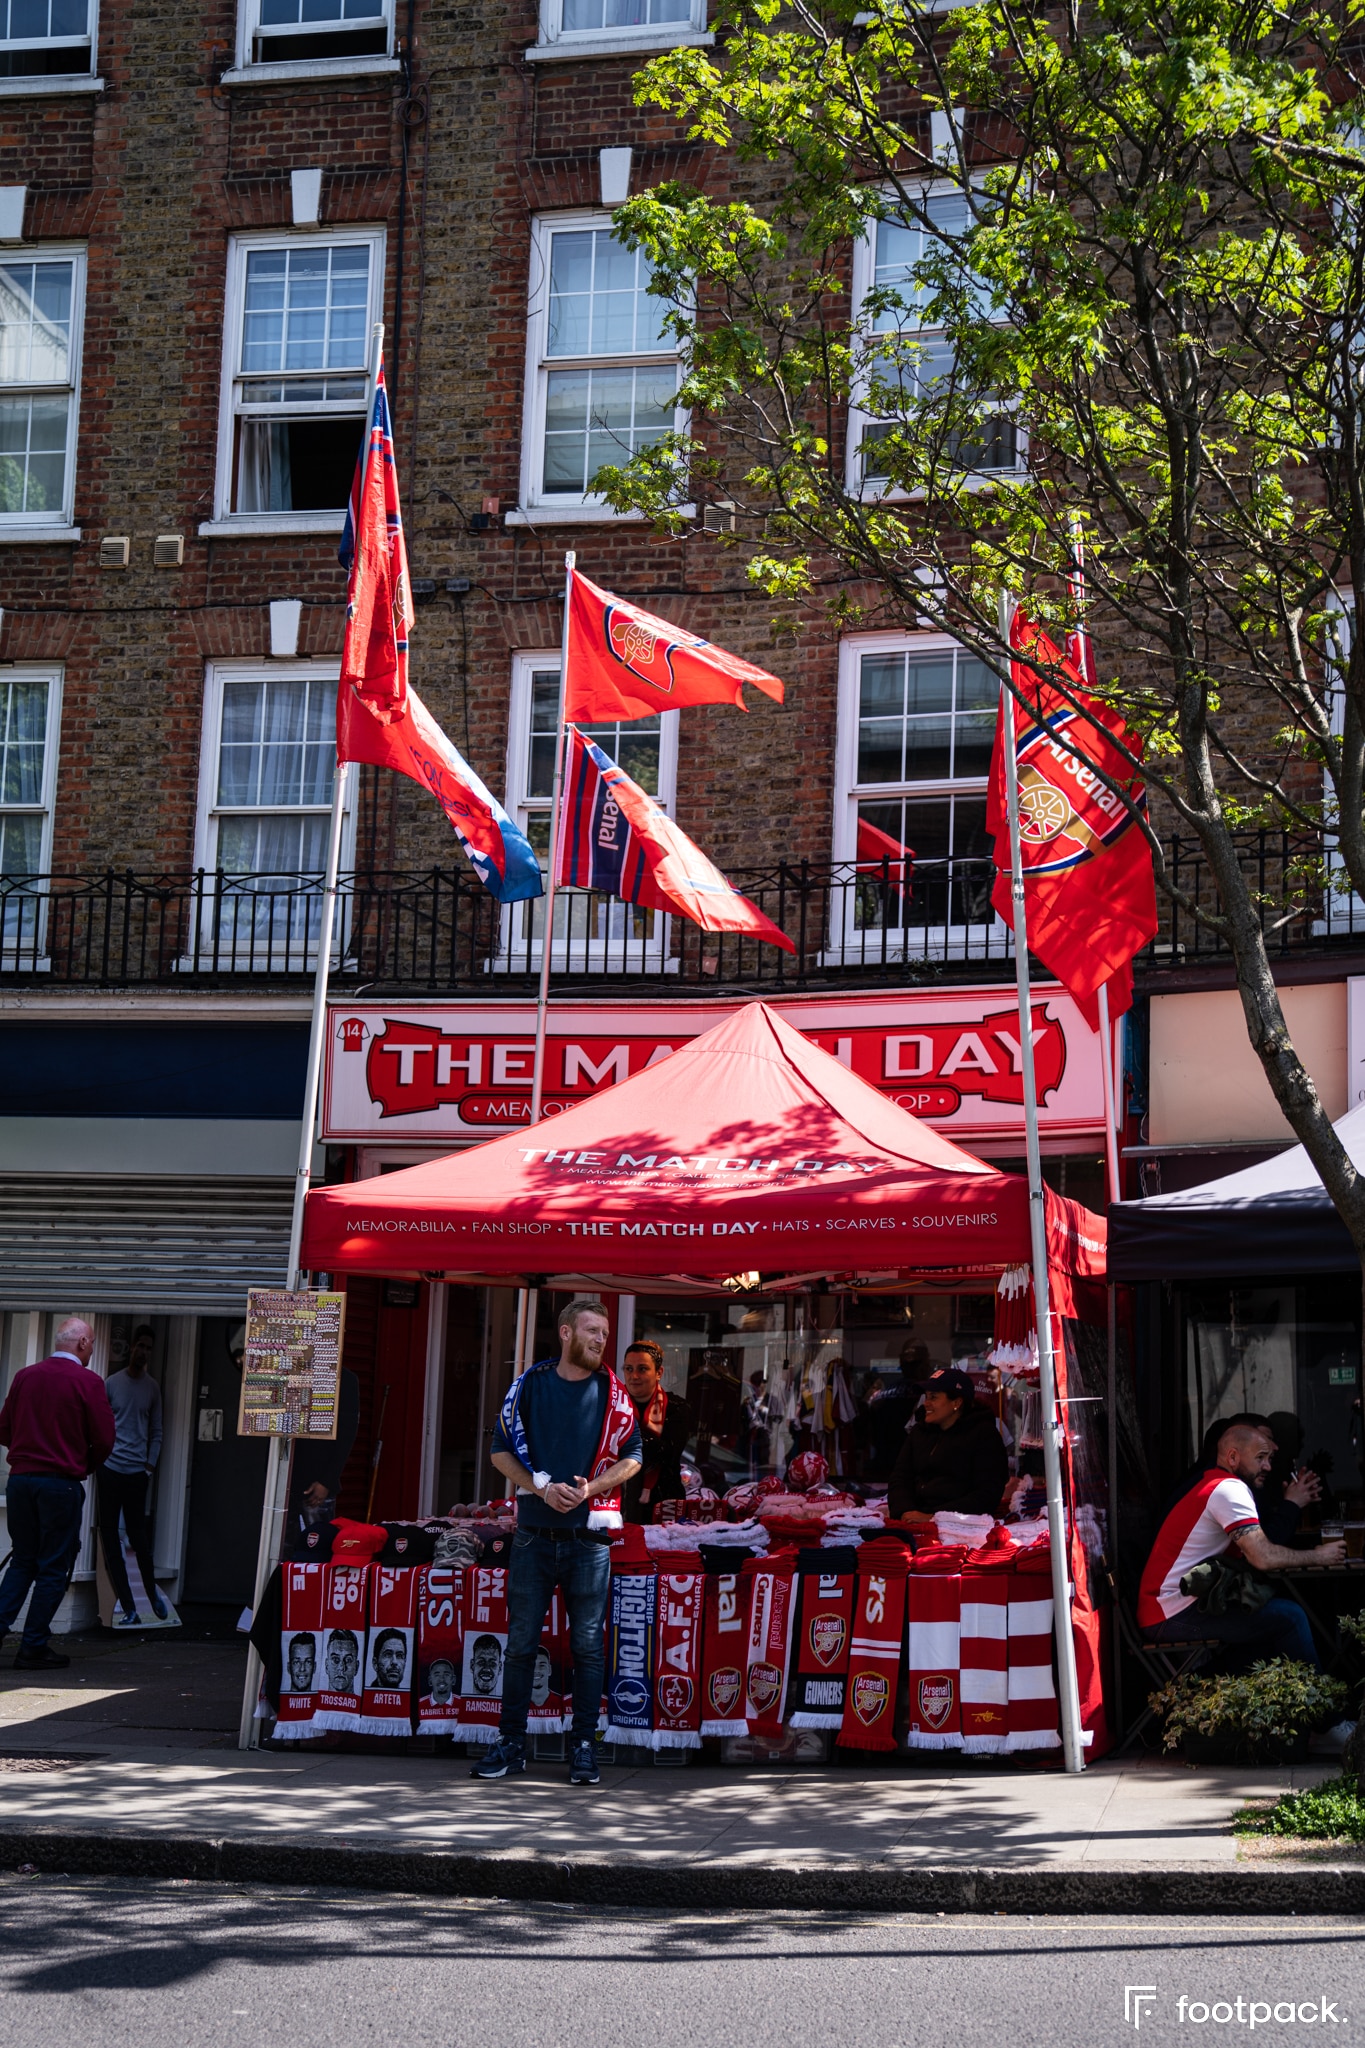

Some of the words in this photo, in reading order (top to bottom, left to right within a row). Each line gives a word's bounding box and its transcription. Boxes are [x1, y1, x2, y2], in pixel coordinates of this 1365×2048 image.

[346, 1024, 360, 1037] 14
[382, 1044, 537, 1085] THE
[885, 1029, 1048, 1078] DAY
[518, 1149, 607, 1166] THE
[616, 1153, 780, 1171] MATCH
[793, 1160, 886, 1172] DAY
[567, 1168, 660, 1178] MEMORABILIA
[346, 1220, 456, 1233] MEMORABILIA
[472, 1222, 503, 1234] FAN
[509, 1222, 551, 1235] SHOP
[566, 1222, 614, 1236] THE
[620, 1222, 704, 1236] MATCH
[712, 1221, 760, 1236] DAY
[772, 1219, 810, 1232] HATS
[825, 1217, 896, 1231] SCARVES
[912, 1213, 998, 1228] SOUVENIRS
[593, 1498, 619, 1508] A.F.C.
[427, 1568, 454, 1627] US
[718, 1574, 742, 1635] nal
[770, 1579, 789, 1651] Arsenal
[816, 1619, 840, 1632] Arsenal
[751, 1667, 776, 1682] Arsenal
[857, 1677, 883, 1691] Arsenal
[924, 1685, 948, 1697] Arsenal
[373, 1692, 401, 1706] ARTETA
[804, 1680, 844, 1706] GUNNERS
[289, 1696, 311, 1710] WHITE
[320, 1694, 357, 1709] TROSSARD
[465, 1700, 503, 1714] RAMSDALE
[420, 1708, 445, 1716] GABRIEL
[612, 1714, 649, 1727] BRIGHTON
[659, 1717, 692, 1729] A.F.C.
